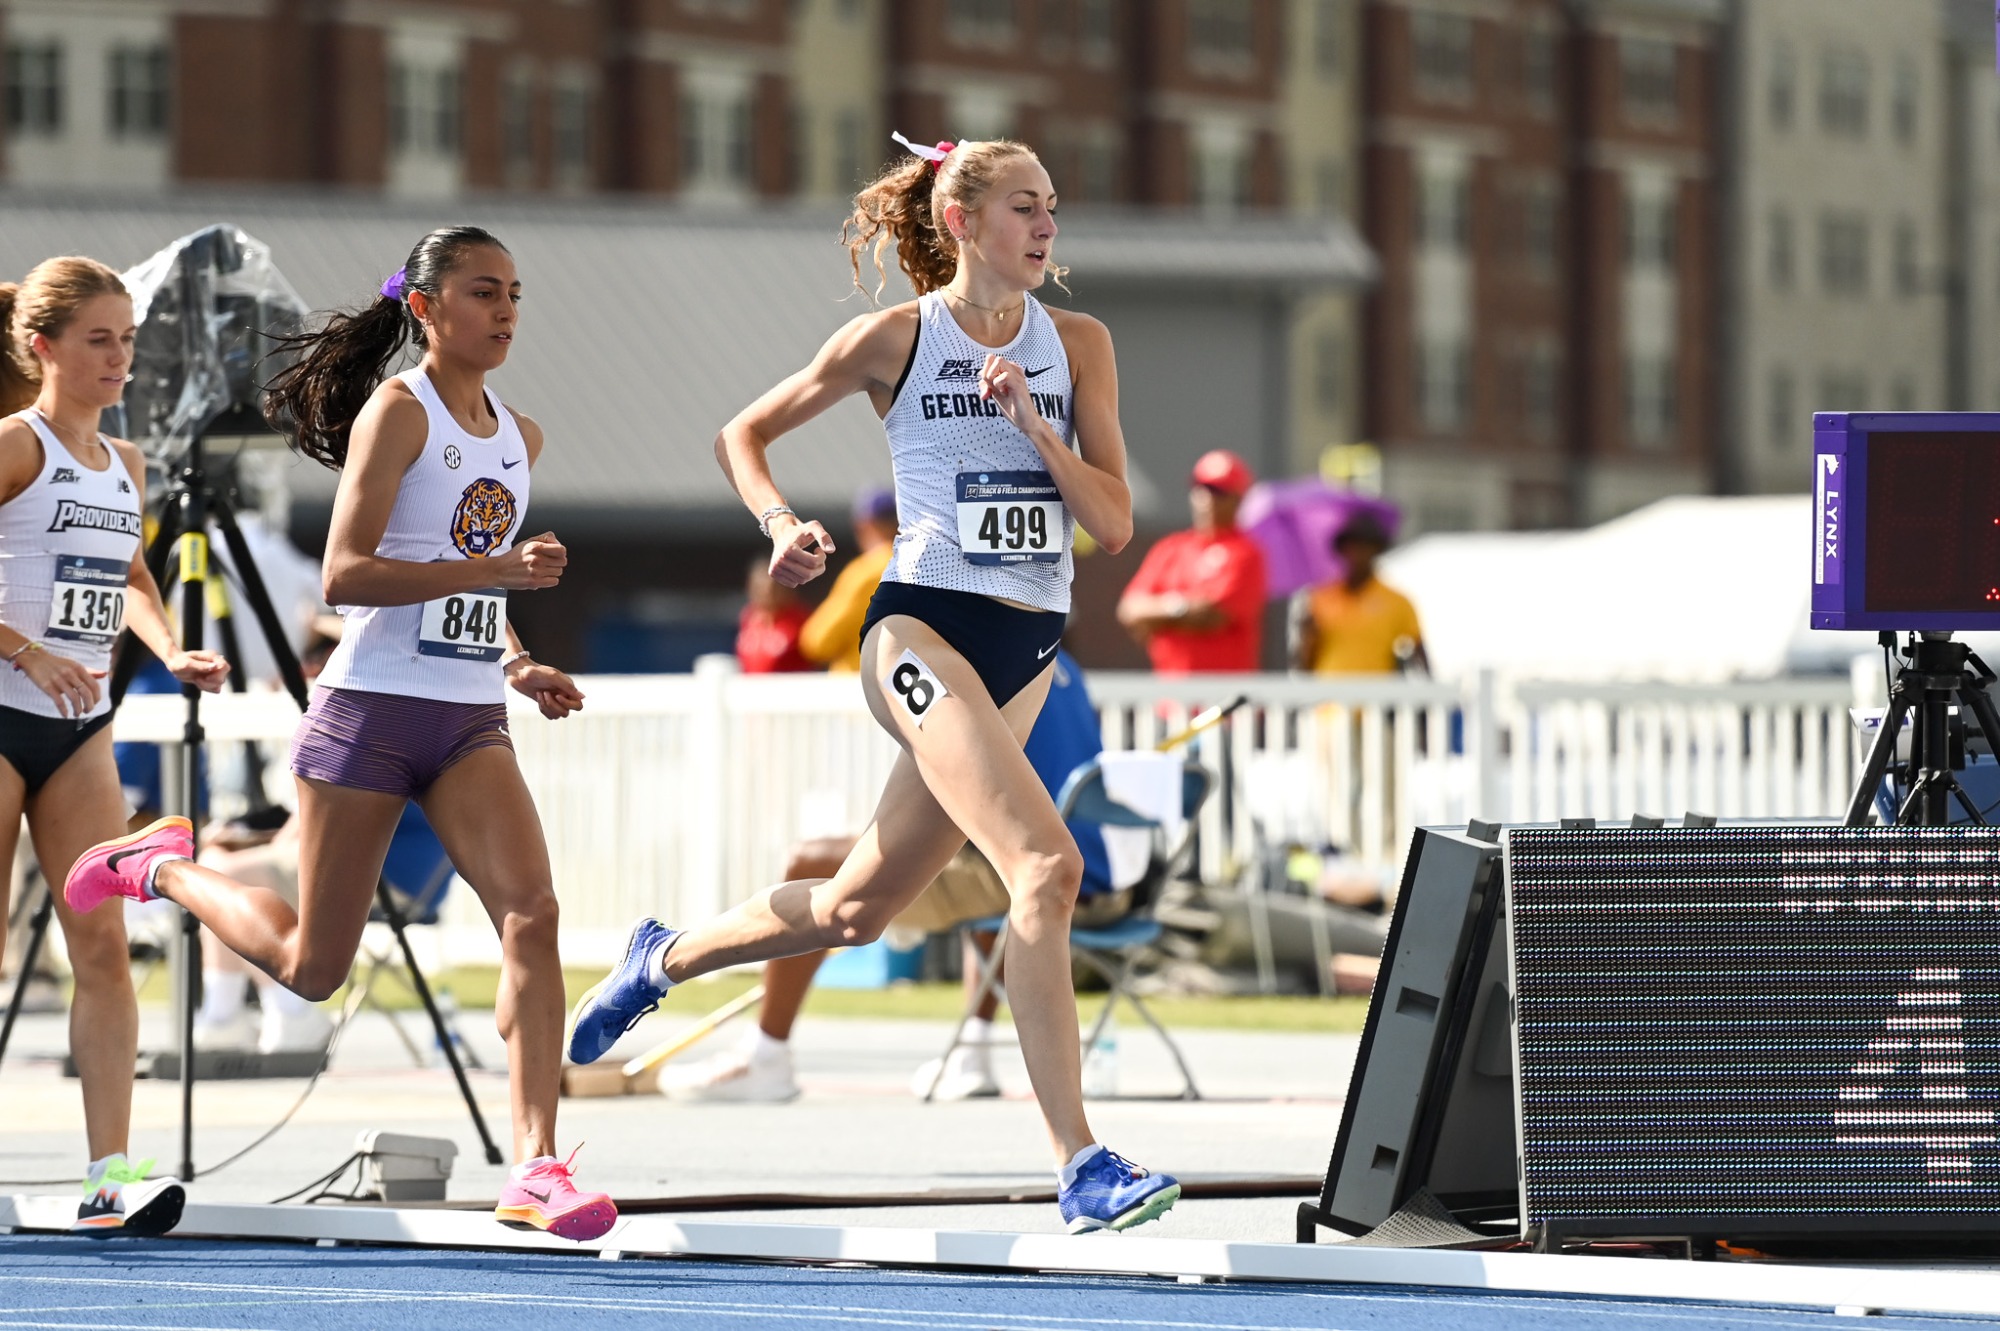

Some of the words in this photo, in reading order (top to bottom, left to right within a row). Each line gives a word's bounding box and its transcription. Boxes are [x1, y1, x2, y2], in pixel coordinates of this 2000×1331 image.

[938, 368, 982, 376] EAST
[942, 359, 975, 368] BIG
[921, 393, 1064, 421] GEORGOWN
[446, 446, 461, 469] SEC
[46, 500, 141, 538] PROVIDENC
[978, 506, 1048, 549] 499
[1826, 491, 1838, 558] LYNX
[58, 588, 124, 632] 1350
[442, 596, 498, 645] 848
[893, 662, 935, 715] 8
